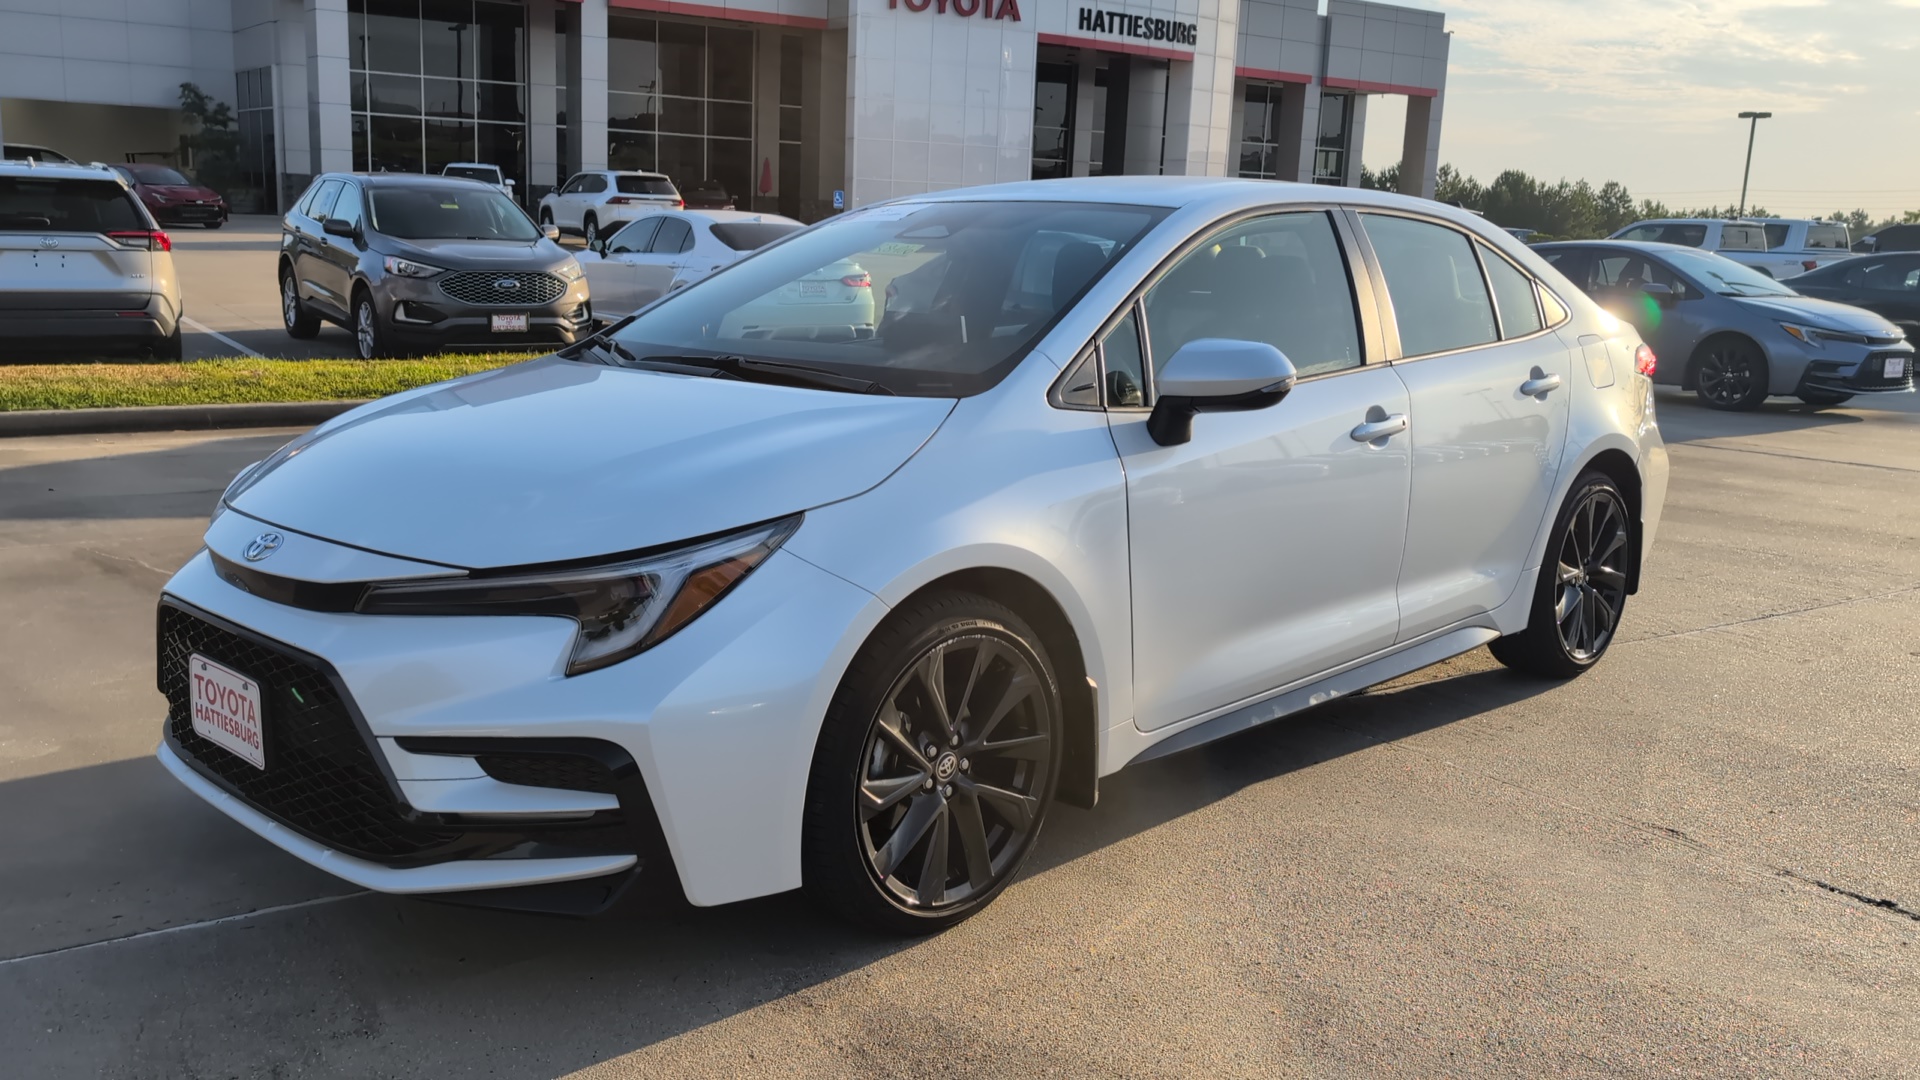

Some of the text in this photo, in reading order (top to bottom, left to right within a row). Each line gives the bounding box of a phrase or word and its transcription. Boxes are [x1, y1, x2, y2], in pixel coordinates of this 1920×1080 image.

[1078, 7, 1198, 46] HATTIESBURG
[194, 673, 257, 729] TOYOTA
[195, 701, 260, 750] HATTIESBURG
